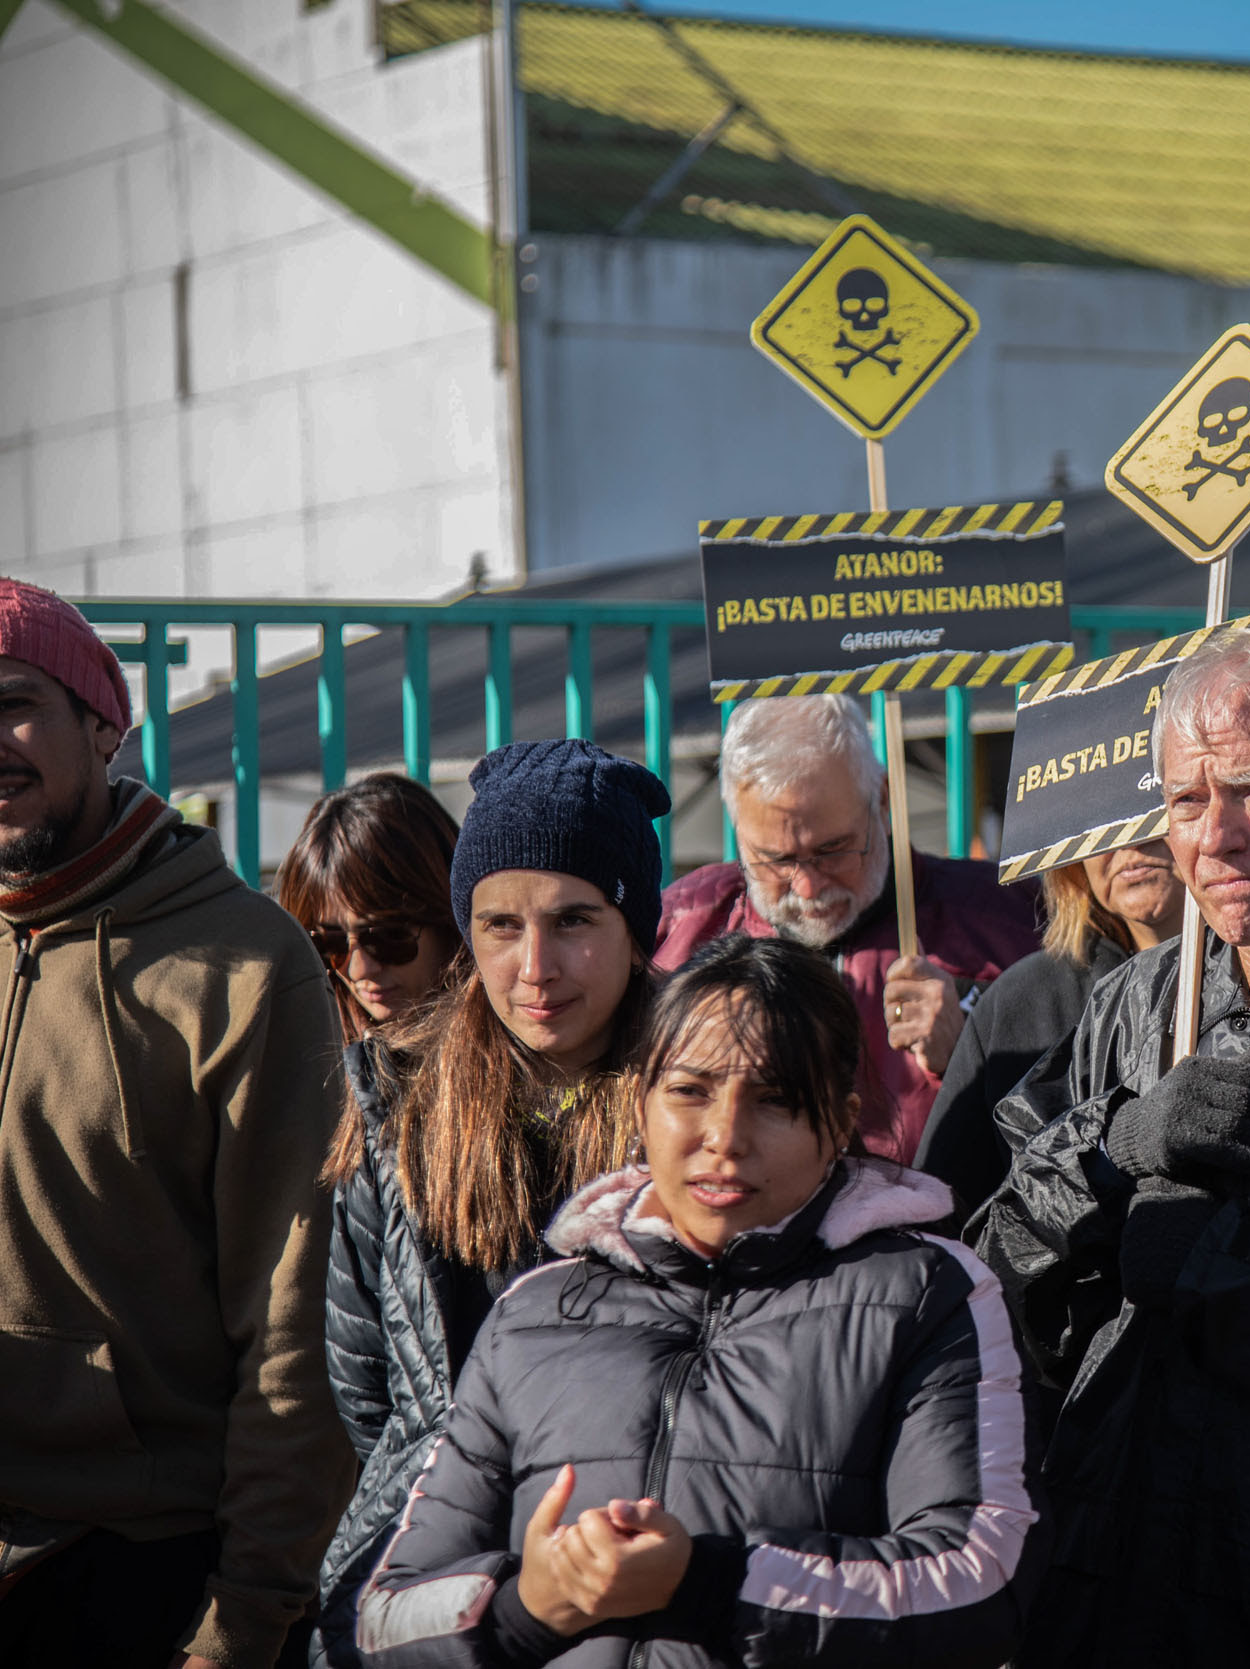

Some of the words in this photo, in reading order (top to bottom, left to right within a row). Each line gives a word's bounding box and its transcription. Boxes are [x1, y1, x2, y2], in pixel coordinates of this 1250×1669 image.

[834, 550, 943, 581] ATANOR:
[717, 597, 808, 632] ¡BASTA
[811, 593, 846, 621] DE
[850, 581, 1064, 619] ENVENENARNOS!
[840, 628, 945, 652] GREENPEACE
[1015, 744, 1108, 803] ¡BASTA
[1112, 730, 1150, 766] DE
